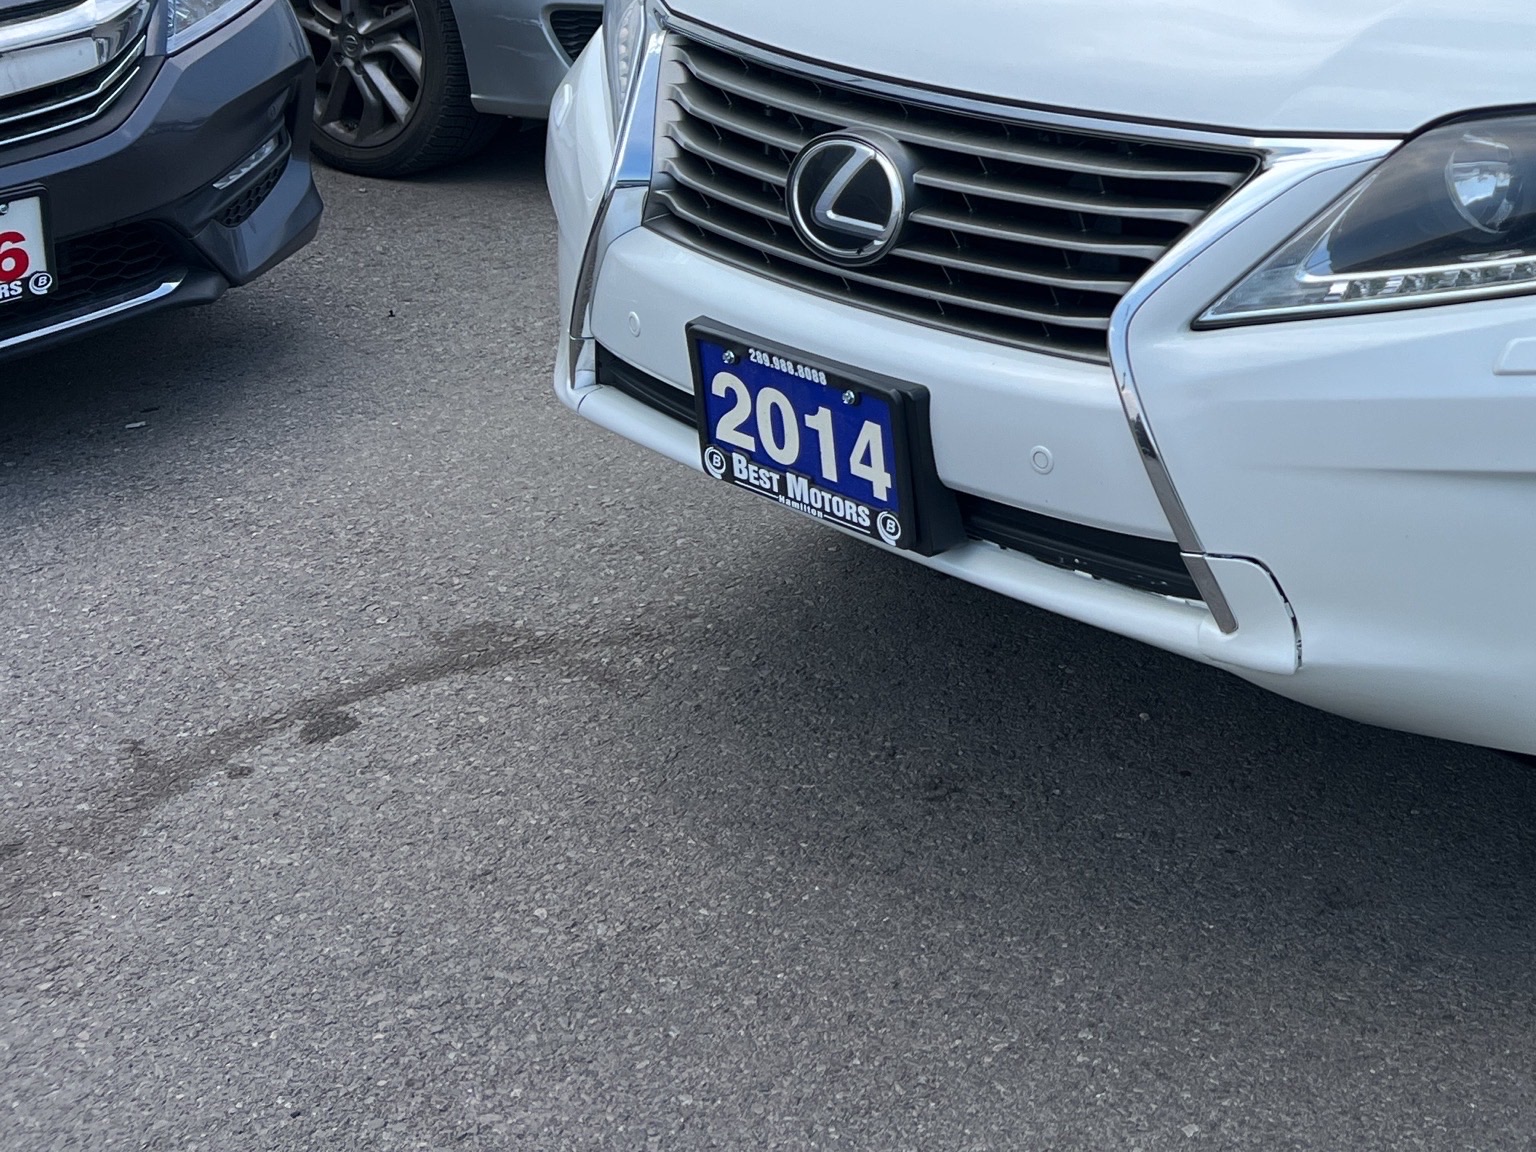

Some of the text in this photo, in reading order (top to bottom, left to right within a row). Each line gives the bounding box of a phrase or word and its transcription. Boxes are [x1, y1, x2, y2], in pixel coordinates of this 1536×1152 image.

[748, 348, 827, 386] 289.988.8088
[711, 371, 892, 502] 2014
[732, 451, 871, 528] BEST MOTORS
[778, 494, 823, 519] Hamilton
